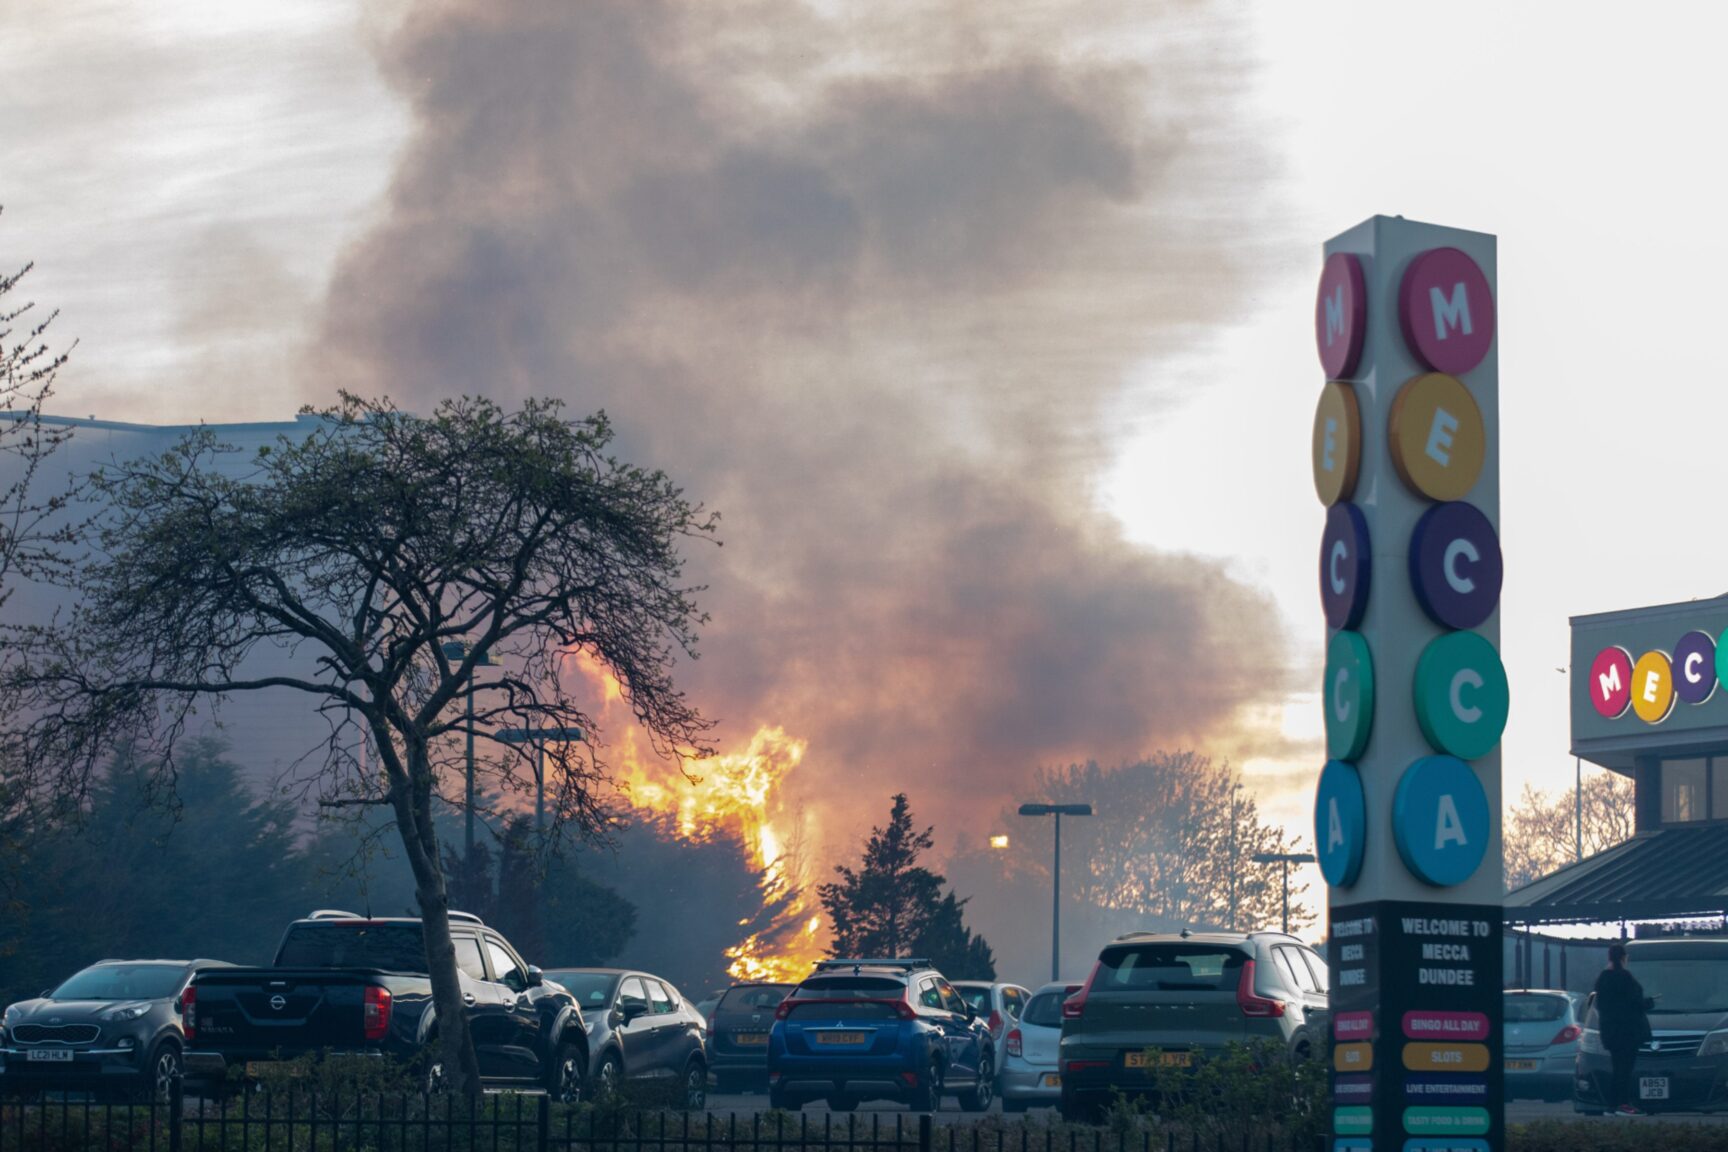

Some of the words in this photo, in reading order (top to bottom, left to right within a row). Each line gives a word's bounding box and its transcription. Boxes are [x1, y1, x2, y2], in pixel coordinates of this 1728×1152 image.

[1425, 281, 1485, 850] MECCA
[1402, 917, 1468, 936] WELCOME
[1472, 920, 1489, 937] TO
[1422, 943, 1470, 961] MECCA
[1418, 968, 1474, 985] DUNDEE
[1410, 1018, 1441, 1031] BINGO
[1442, 1019, 1460, 1031] ALL
[1461, 1020, 1480, 1032] DAY
[1431, 1050, 1462, 1063] SLOTS
[1406, 1083, 1424, 1093] LIVE
[1425, 1084, 1486, 1094] ENTERTAINMENT
